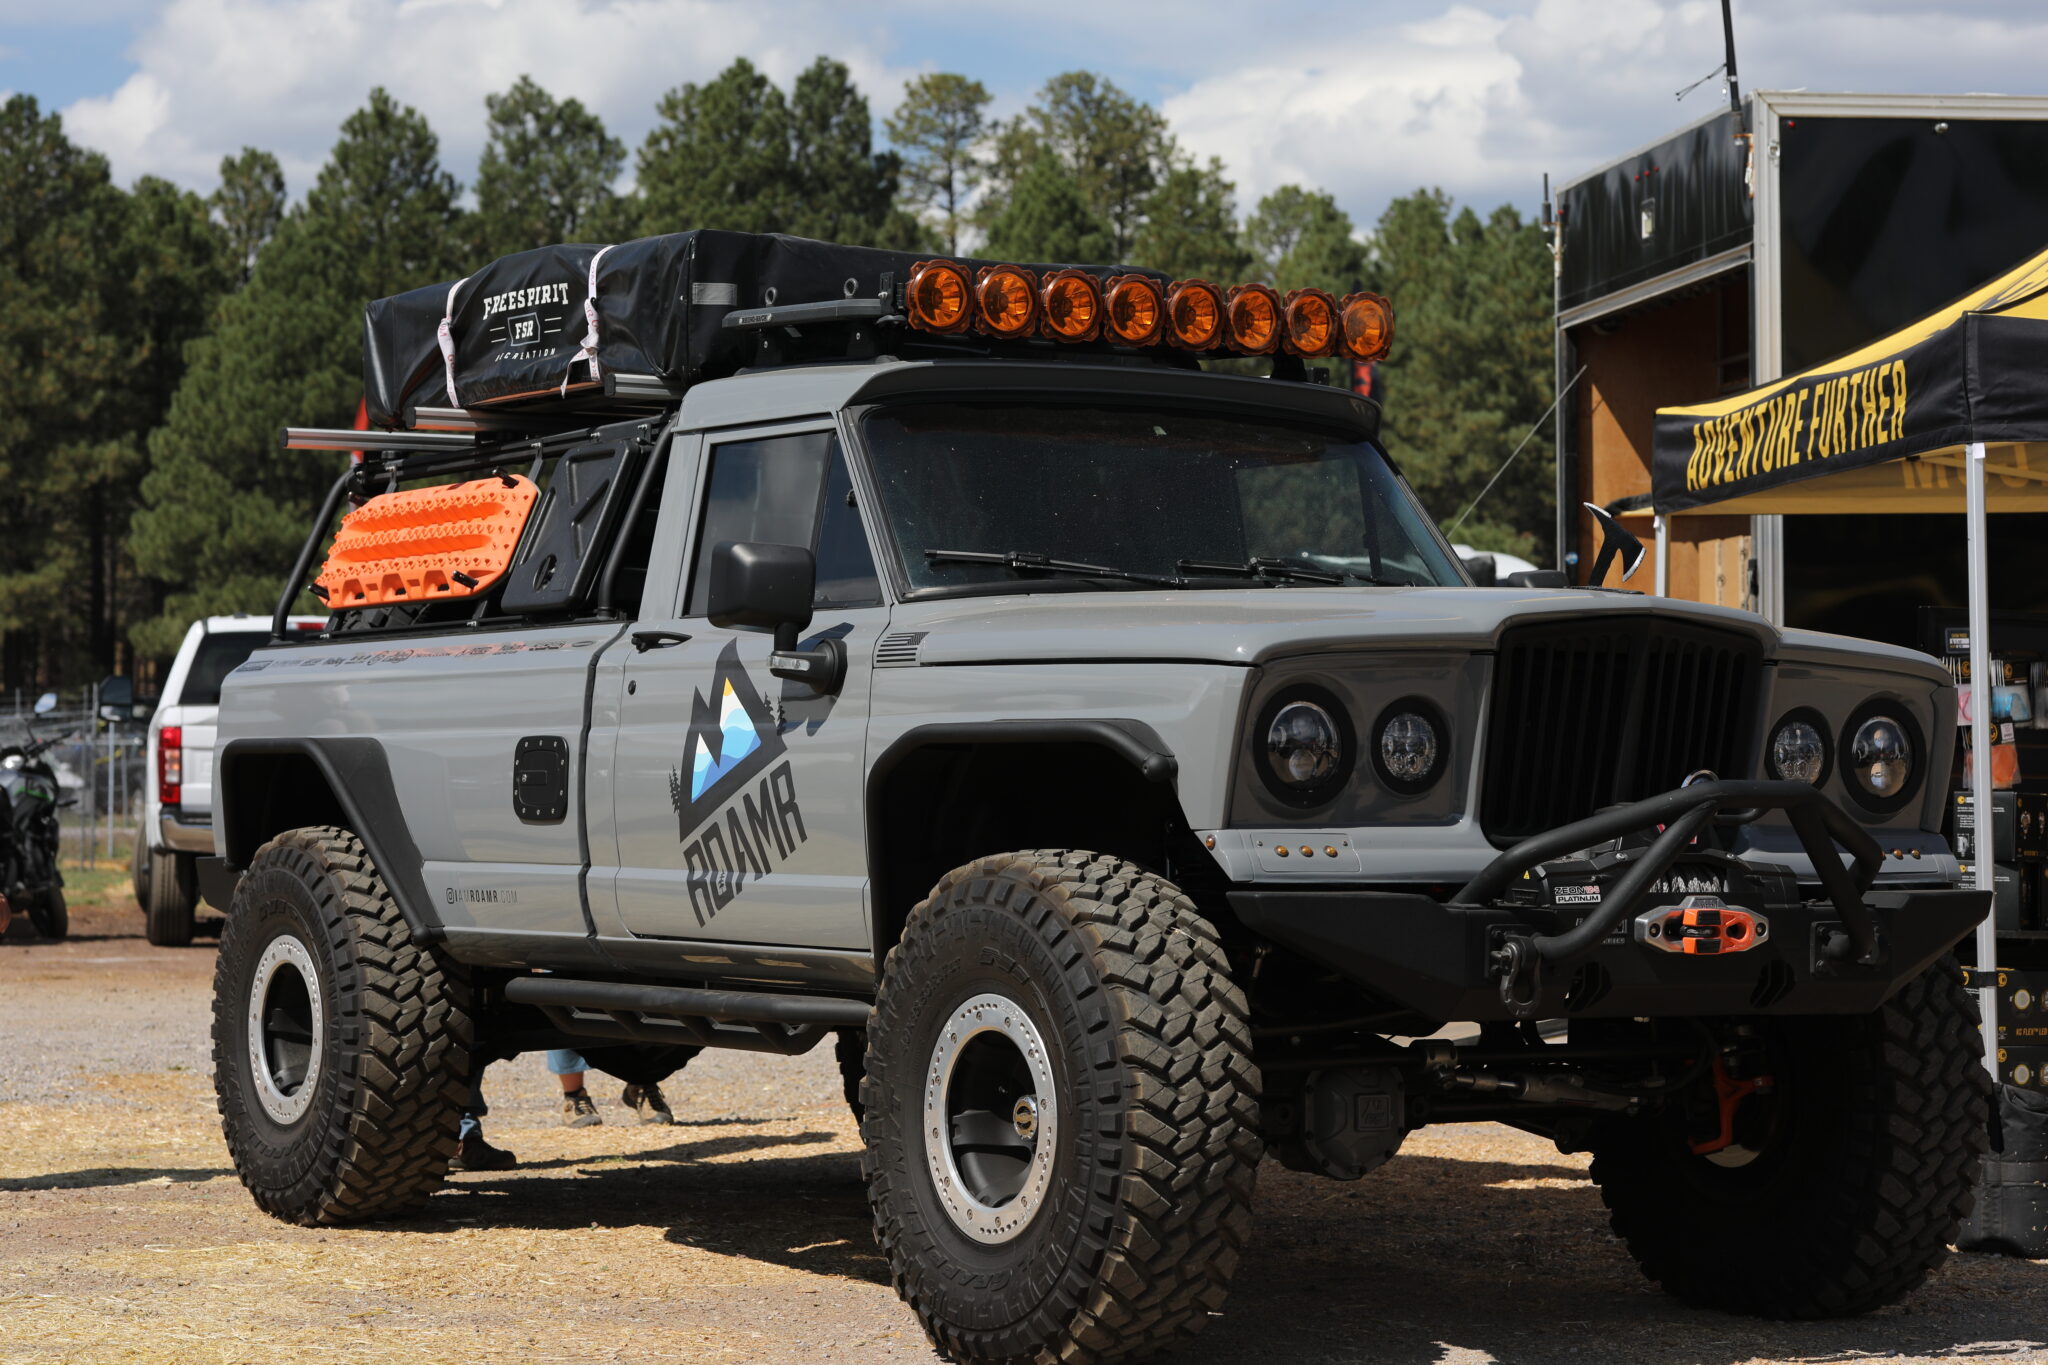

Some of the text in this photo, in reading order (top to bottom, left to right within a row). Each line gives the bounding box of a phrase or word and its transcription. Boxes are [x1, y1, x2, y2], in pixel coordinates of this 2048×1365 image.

[482, 282, 569, 321] FREESPIRIT
[514, 319, 534, 340] FSR
[1686, 388, 1809, 492] ADVENTURE
[1806, 359, 1907, 462] FURTHER
[683, 759, 808, 929] ROAMR
[1557, 895, 1599, 903] PLATINUM
